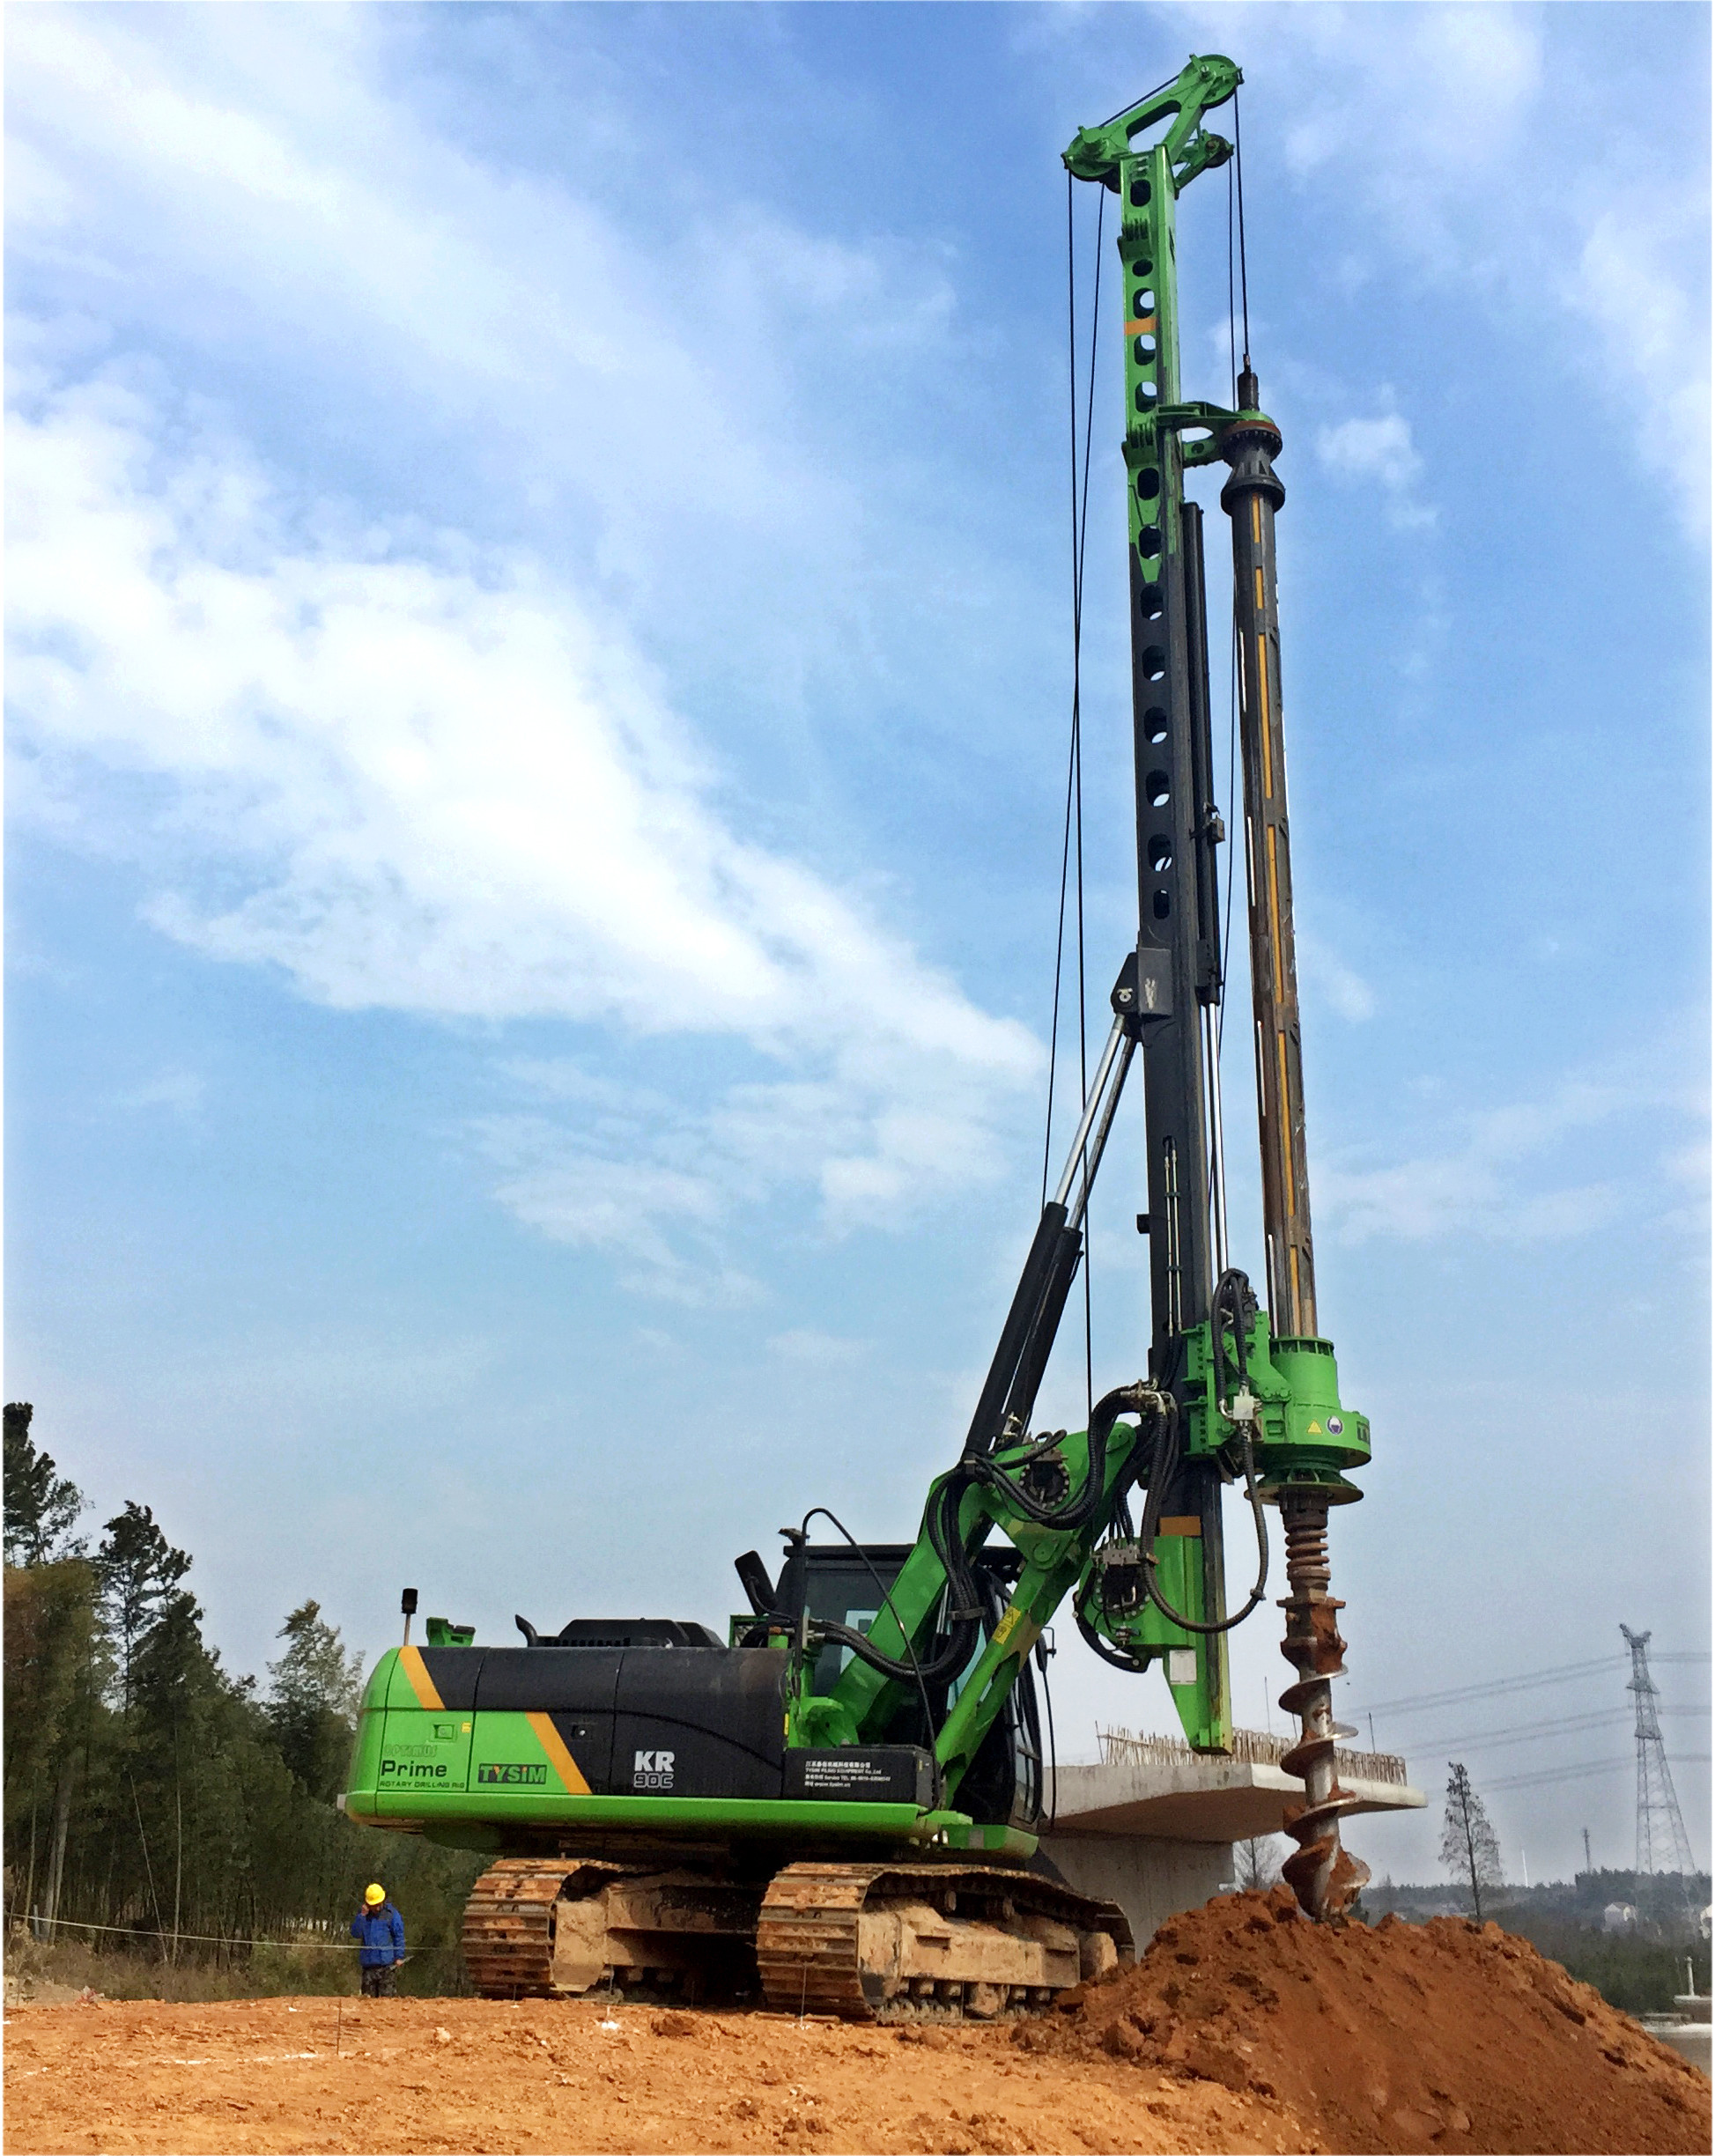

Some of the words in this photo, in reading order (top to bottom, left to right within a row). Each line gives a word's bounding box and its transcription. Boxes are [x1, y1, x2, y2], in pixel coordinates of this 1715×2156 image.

[381, 1760, 447, 1777] Prime
[634, 1750, 676, 1772] KR
[633, 1772, 675, 1789] 90C
